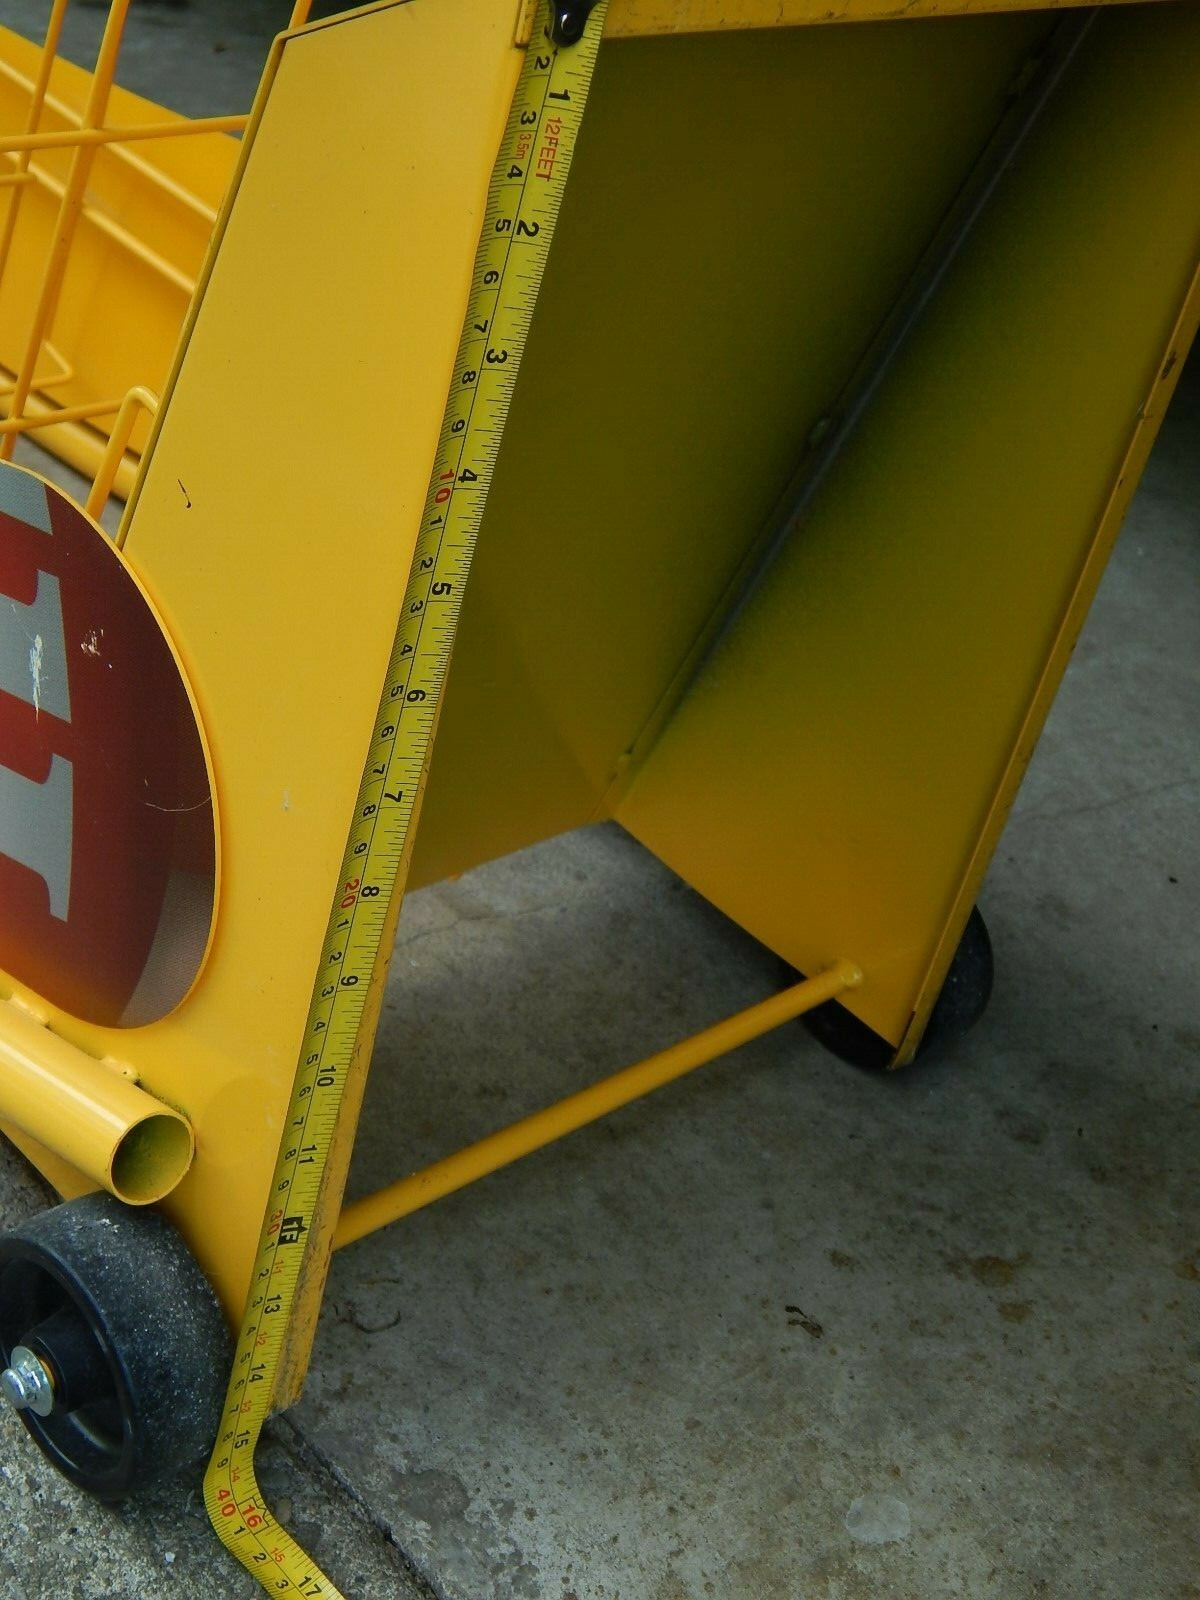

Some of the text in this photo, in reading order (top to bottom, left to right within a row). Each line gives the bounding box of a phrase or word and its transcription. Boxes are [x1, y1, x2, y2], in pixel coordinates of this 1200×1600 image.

[534, 56, 550, 70] 2
[549, 89, 570, 101] 1
[521, 111, 536, 125] 3
[507, 165, 522, 179] 4
[496, 219, 511, 232] 5
[517, 220, 539, 237] 2
[484, 271, 499, 284] 6
[475, 320, 488, 333] 7
[486, 349, 507, 363] 3
[462, 370, 476, 384] 8
[452, 420, 465, 433] 9
[458, 469, 477, 483] 4
[435, 469, 454, 504] 10
[430, 515, 442, 525] 1
[420, 557, 433, 570] 2
[432, 582, 452, 595] 5
[410, 600, 423, 613] 3
[400, 644, 412, 655] 4
[391, 685, 404, 697] 5
[407, 690, 426, 702] 6
[381, 726, 394, 738] 6
[373, 764, 385, 774] 7
[384, 791, 402, 802] 7
[363, 804, 376, 817] 8
[354, 843, 367, 854] 9
[341, 879, 359, 908] 20
[361, 886, 379, 897] 8
[337, 919, 349, 928] 1
[329, 952, 342, 964] 2
[341, 976, 358, 986] 9
[322, 986, 334, 997] 3
[314, 1022, 325, 1031] 4
[306, 1054, 318, 1065] 5
[317, 1066, 336, 1087] 10
[299, 1086, 311, 1097] 6
[293, 1117, 304, 1126] 7
[285, 1149, 296, 1160] 8
[299, 1145, 317, 1164] 11
[278, 1180, 289, 1191] 9
[267, 1210, 283, 1236] 30
[264, 1295, 282, 1314] 13
[249, 1364, 266, 1383] 14
[234, 1430, 251, 1449] 15
[217, 1458, 228, 1468] 9
[218, 1489, 236, 1517] 40
[242, 1504, 262, 1528] 16
[234, 1526, 246, 1535] 1
[253, 1552, 267, 1563] 2
[276, 1579, 289, 1589] 3
[298, 1576, 322, 1597] 17
